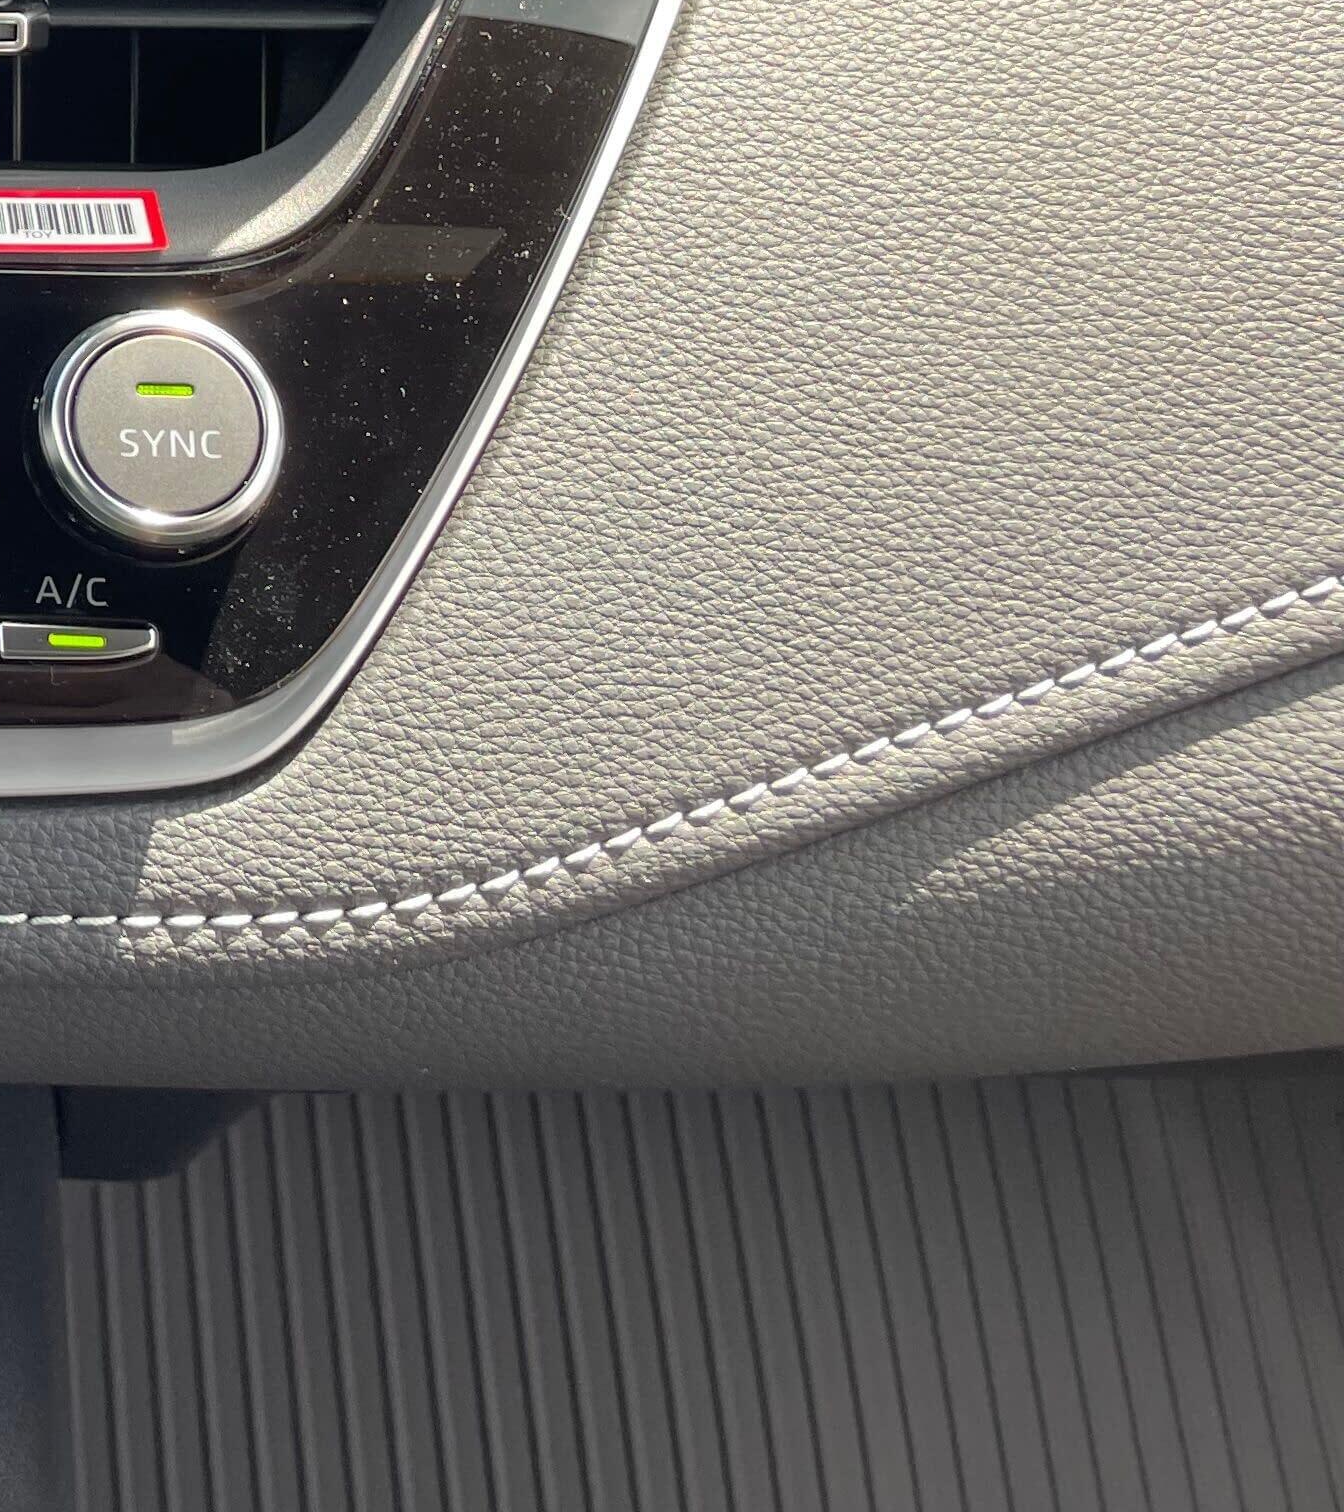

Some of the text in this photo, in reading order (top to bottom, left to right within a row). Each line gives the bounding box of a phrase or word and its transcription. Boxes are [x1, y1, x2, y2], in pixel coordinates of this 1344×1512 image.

[23, 229, 53, 240] TOY
[119, 427, 223, 460] SYNC
[35, 573, 108, 610] A/C
